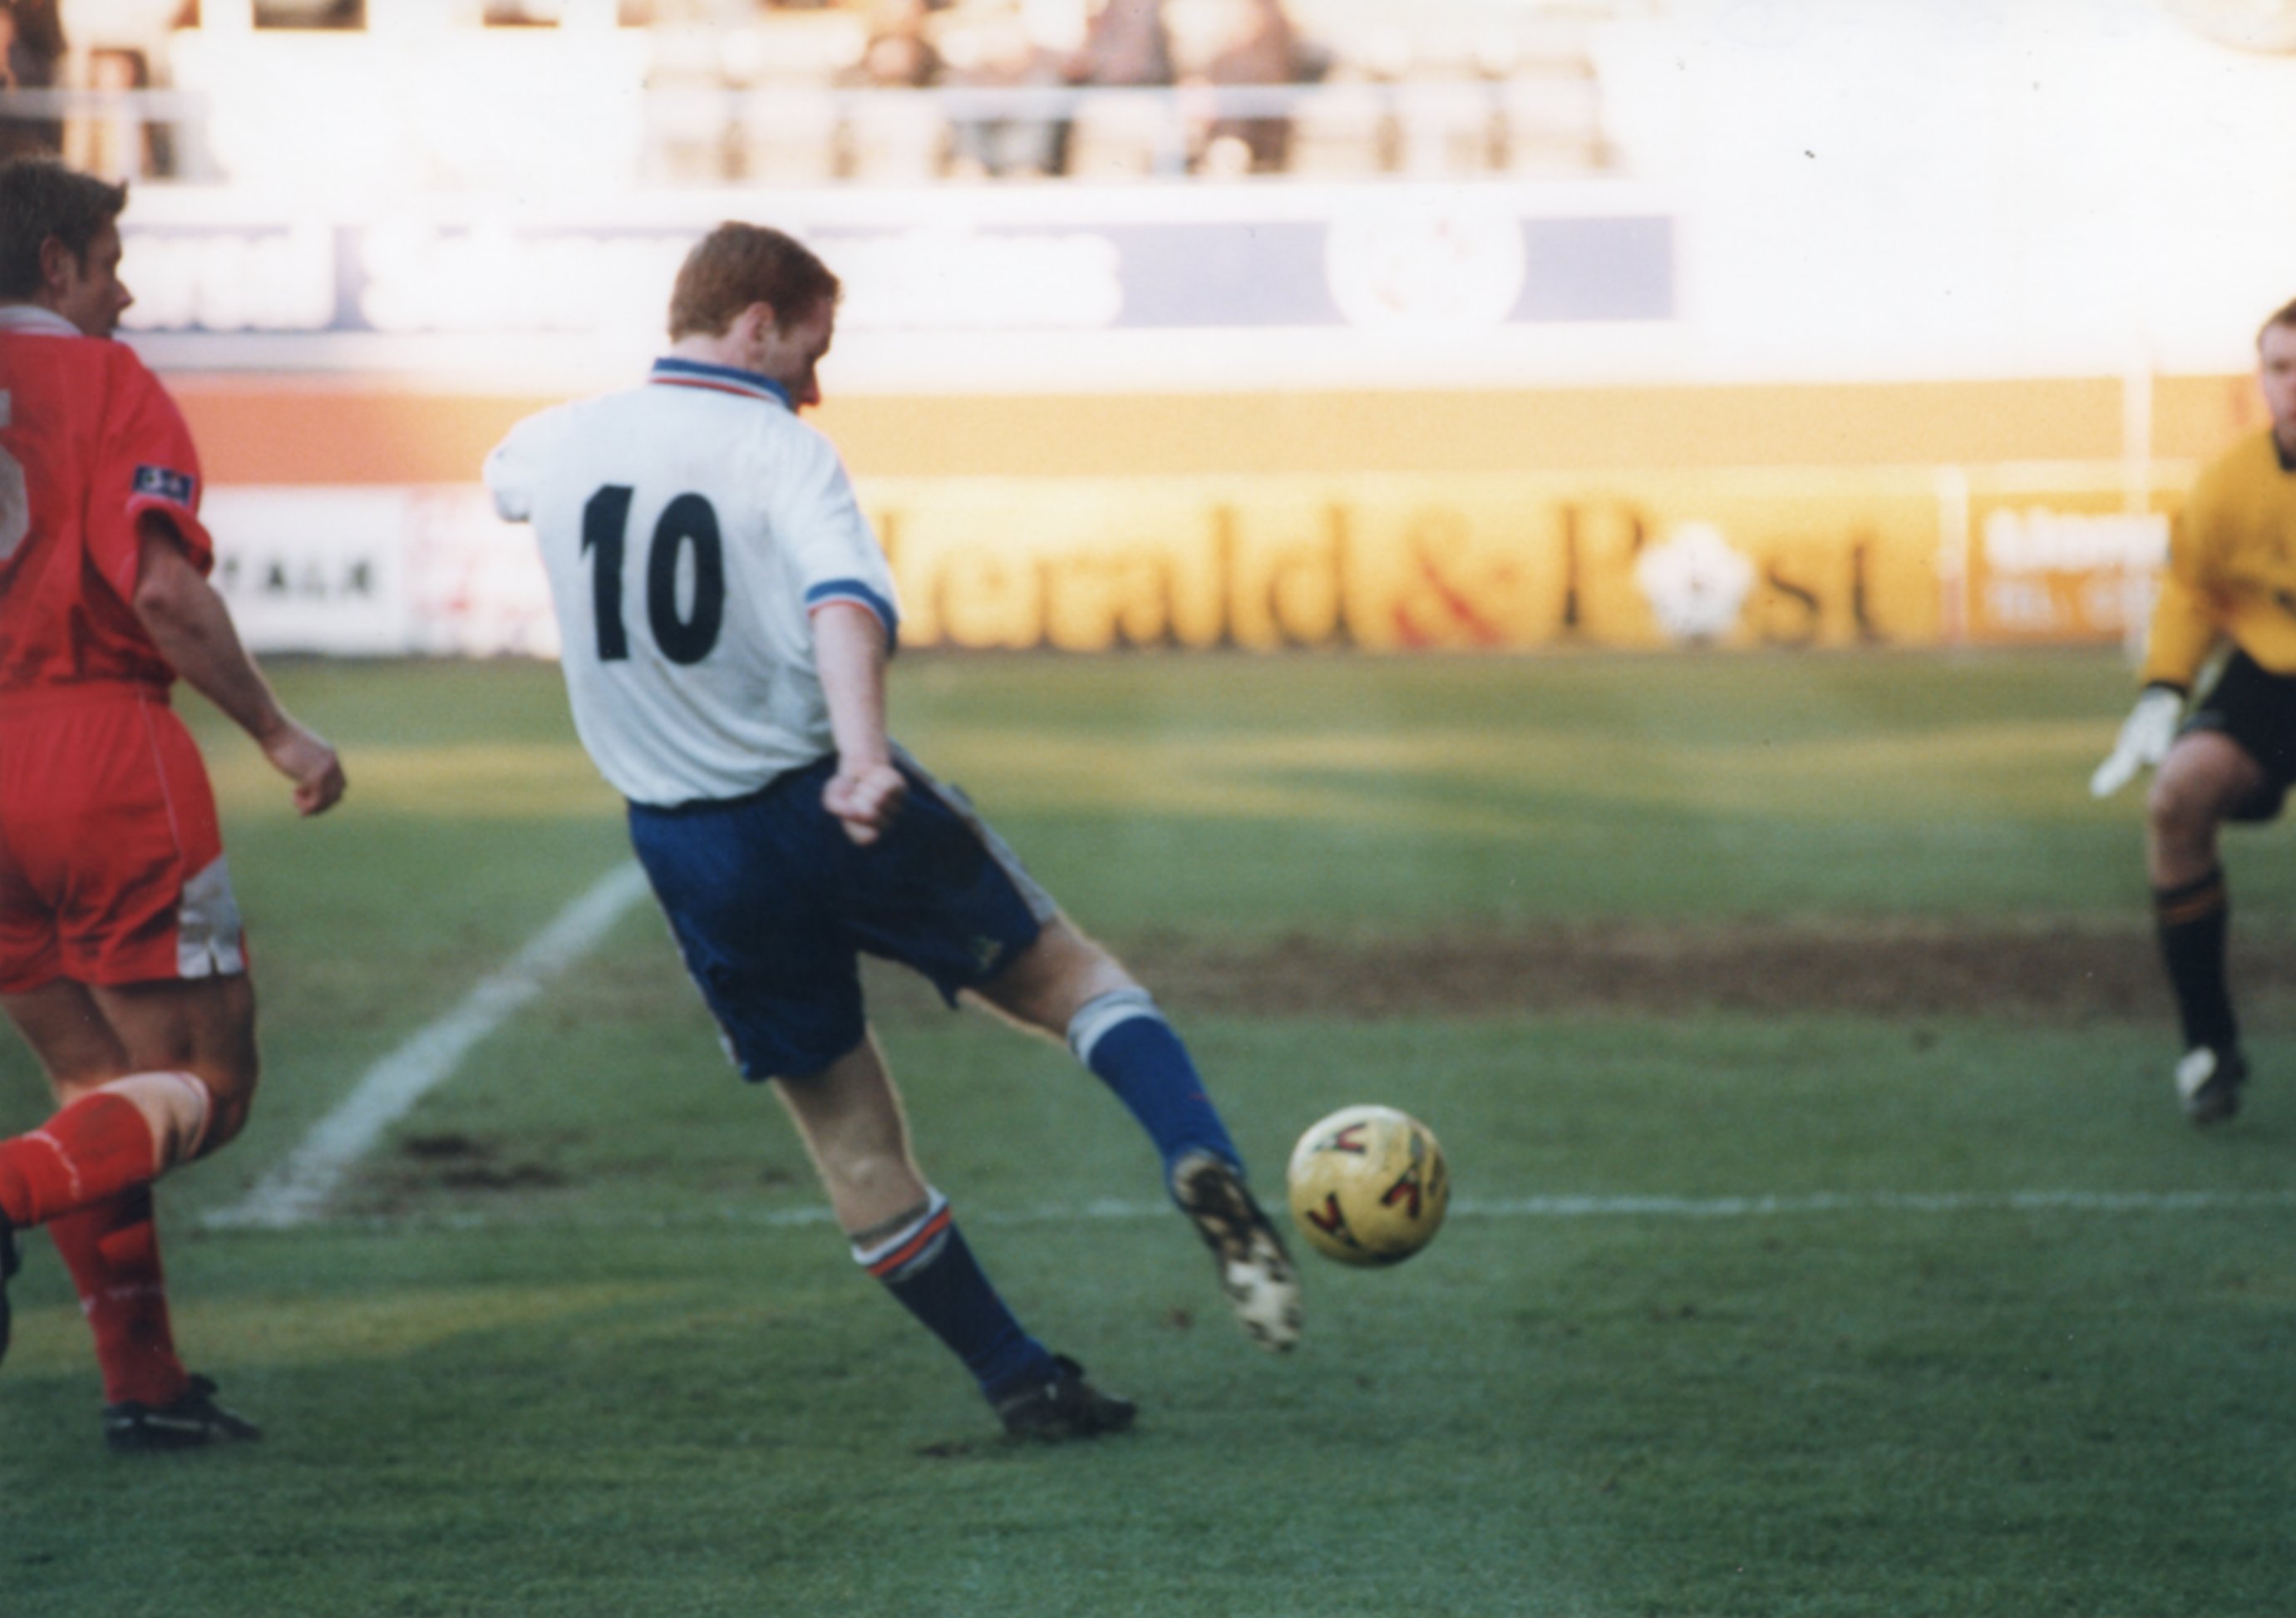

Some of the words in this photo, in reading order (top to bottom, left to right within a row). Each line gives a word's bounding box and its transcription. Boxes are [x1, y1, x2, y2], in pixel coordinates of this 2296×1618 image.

[580, 483, 725, 664] 10
[878, 501, 1358, 652] erald
[1383, 504, 1523, 652] &
[1551, 492, 1885, 652] Pst
